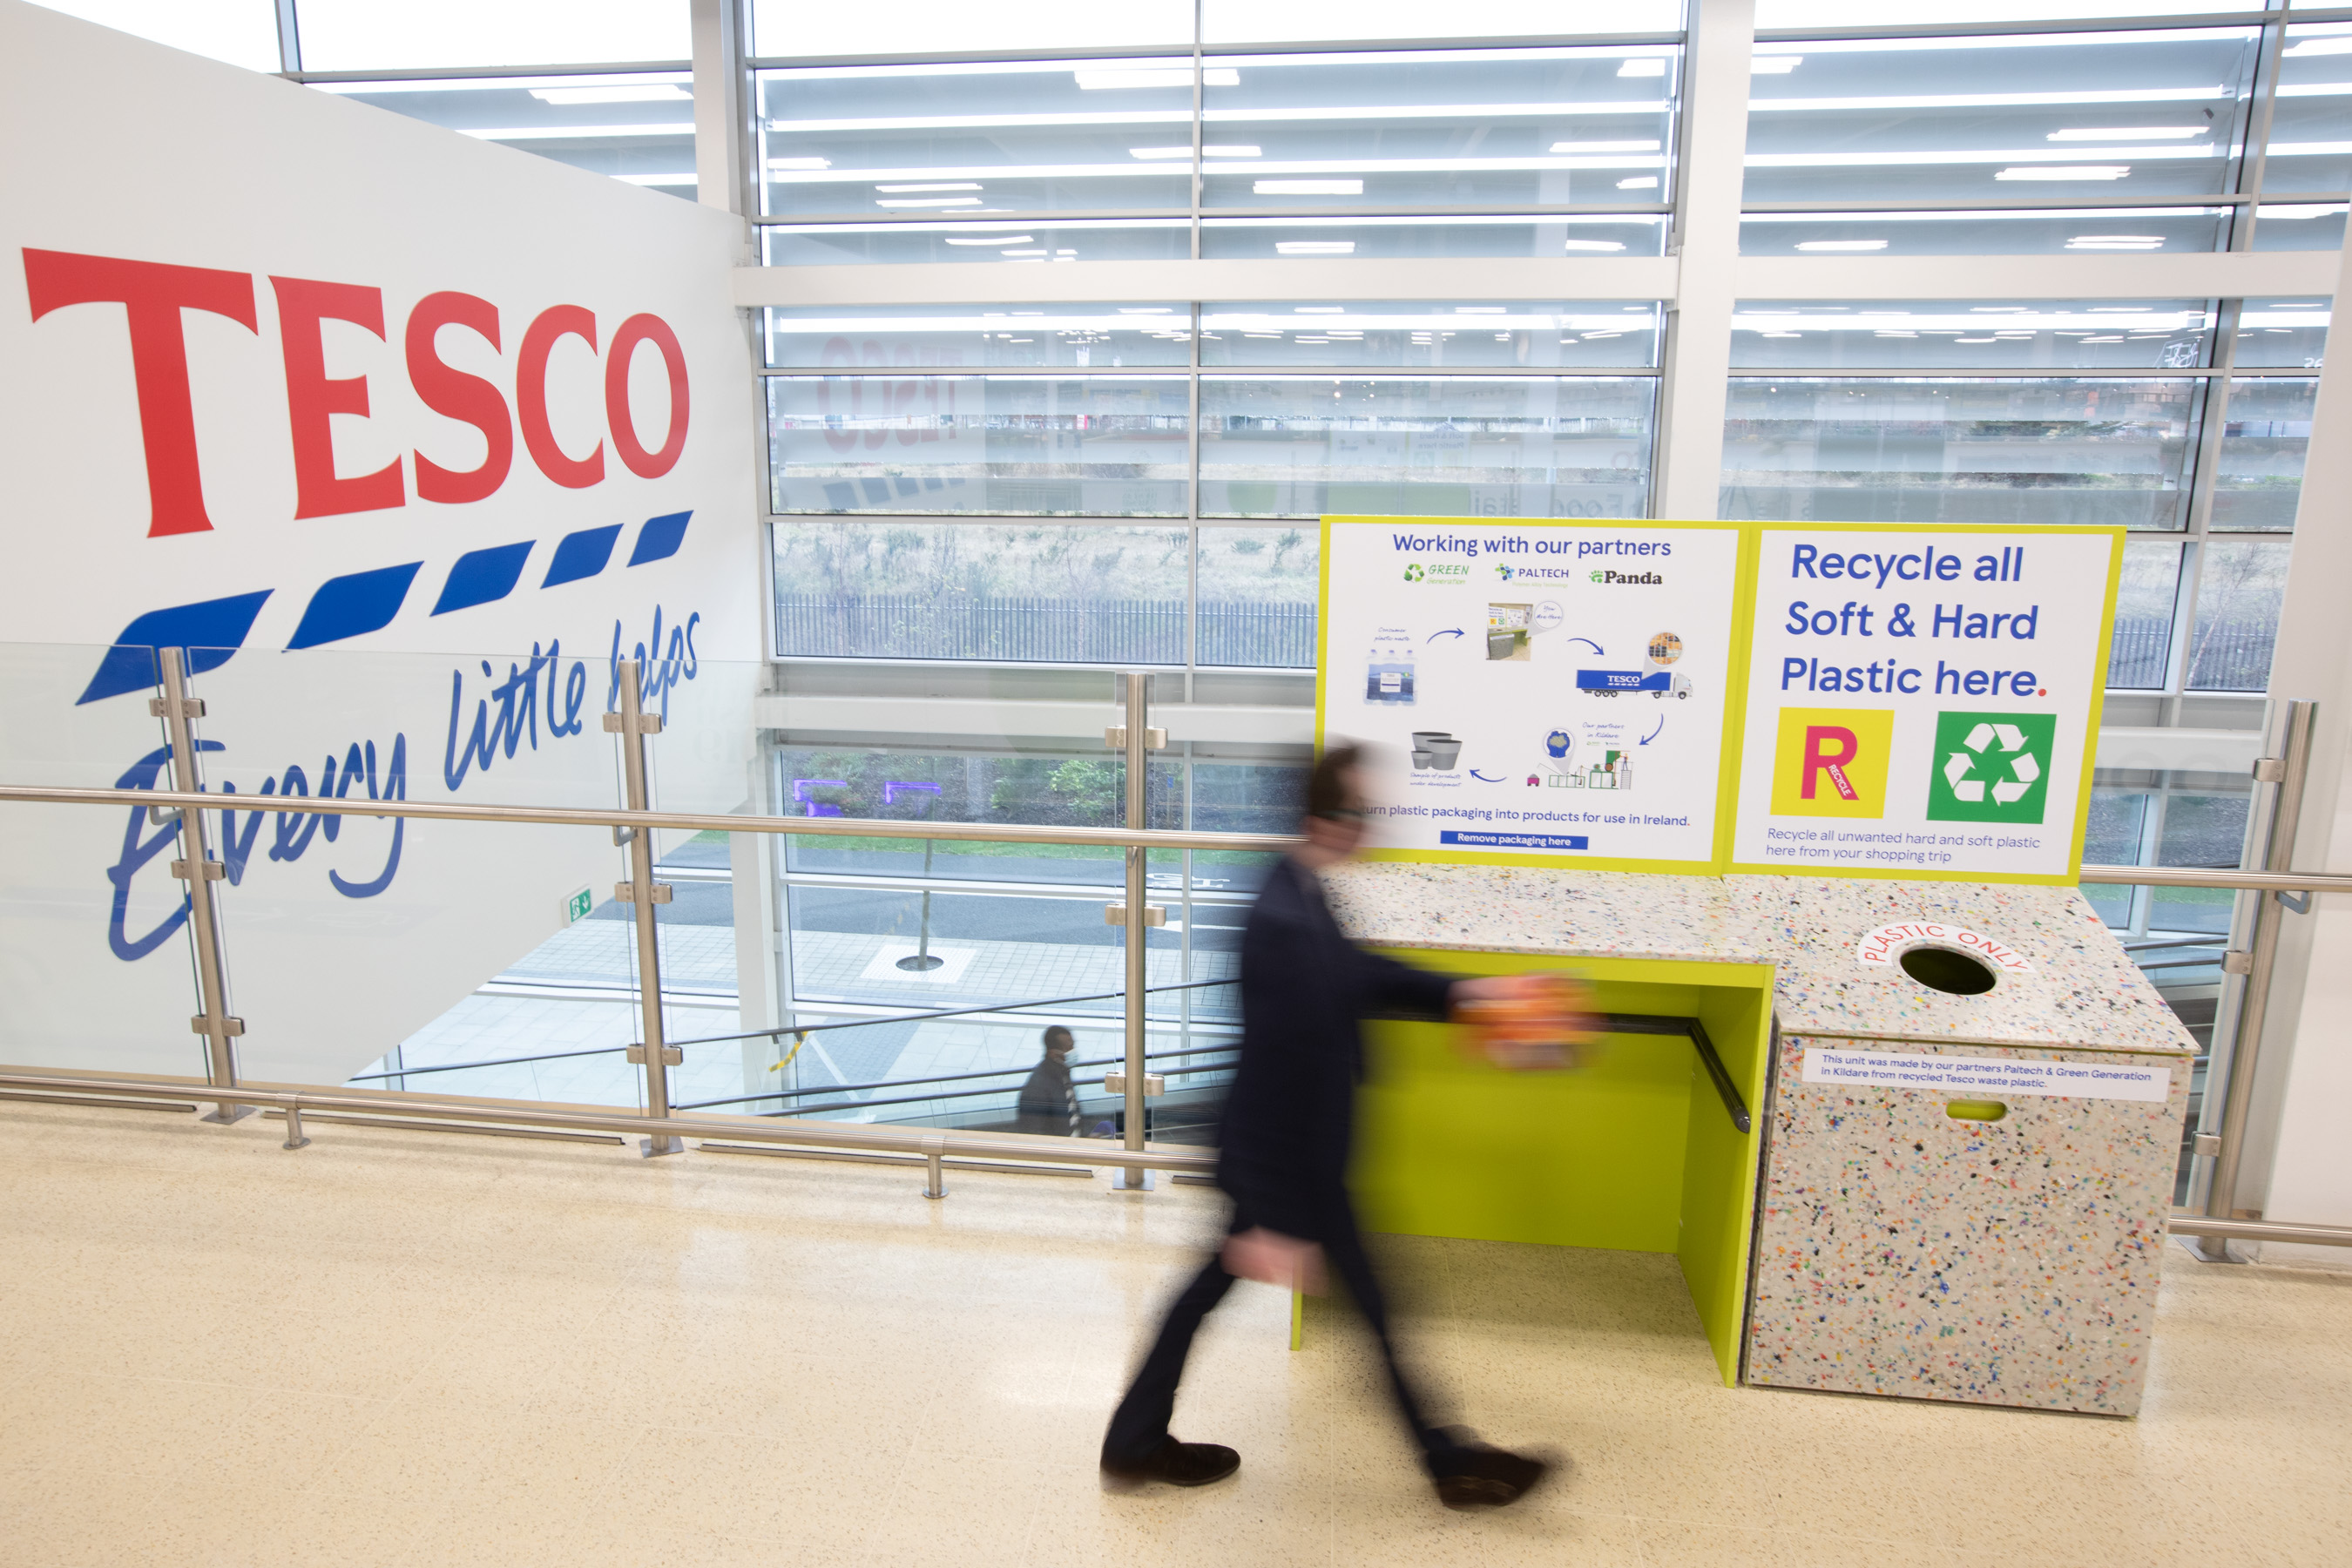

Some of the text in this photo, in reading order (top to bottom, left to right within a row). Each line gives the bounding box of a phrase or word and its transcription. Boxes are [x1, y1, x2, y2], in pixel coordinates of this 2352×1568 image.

[22, 247, 690, 537] TESCO
[1393, 534, 1672, 559] Working with our partners
[1428, 564, 1470, 576] GREEN
[1518, 568, 1570, 578] PALTECH
[1604, 571, 1663, 585] Panda
[1791, 544, 2024, 589] Recycle all
[1426, 577, 1466, 585] Generation
[1785, 601, 2039, 639] Soft & Hard
[1781, 657, 2047, 697] Plastic here.
[443, 638, 587, 792] little
[1801, 725, 1860, 801] R
[1828, 763, 1852, 796] RECYCLE
[1389, 805, 1429, 817] plastic
[1431, 807, 1492, 821] packaging
[1495, 808, 1520, 820] into
[1523, 810, 1579, 822] products
[1583, 812, 1601, 823] for
[1604, 815, 1626, 824] use
[1629, 814, 1640, 825] in
[1644, 814, 1691, 827] Ireland.
[1457, 833, 1571, 847] Remove packaging here
[1767, 828, 2041, 849] Recycle all unwanted hard and soft plastic
[1766, 845, 1952, 863] here from your shopping trip
[1864, 924, 2029, 970] PLASTIC ONLY
[1821, 1054, 2152, 1081] This unit was made by our partners Paltech & Green Generation
[1821, 1066, 2048, 1089] in Kildare from recycled Tesco waste plastic.
